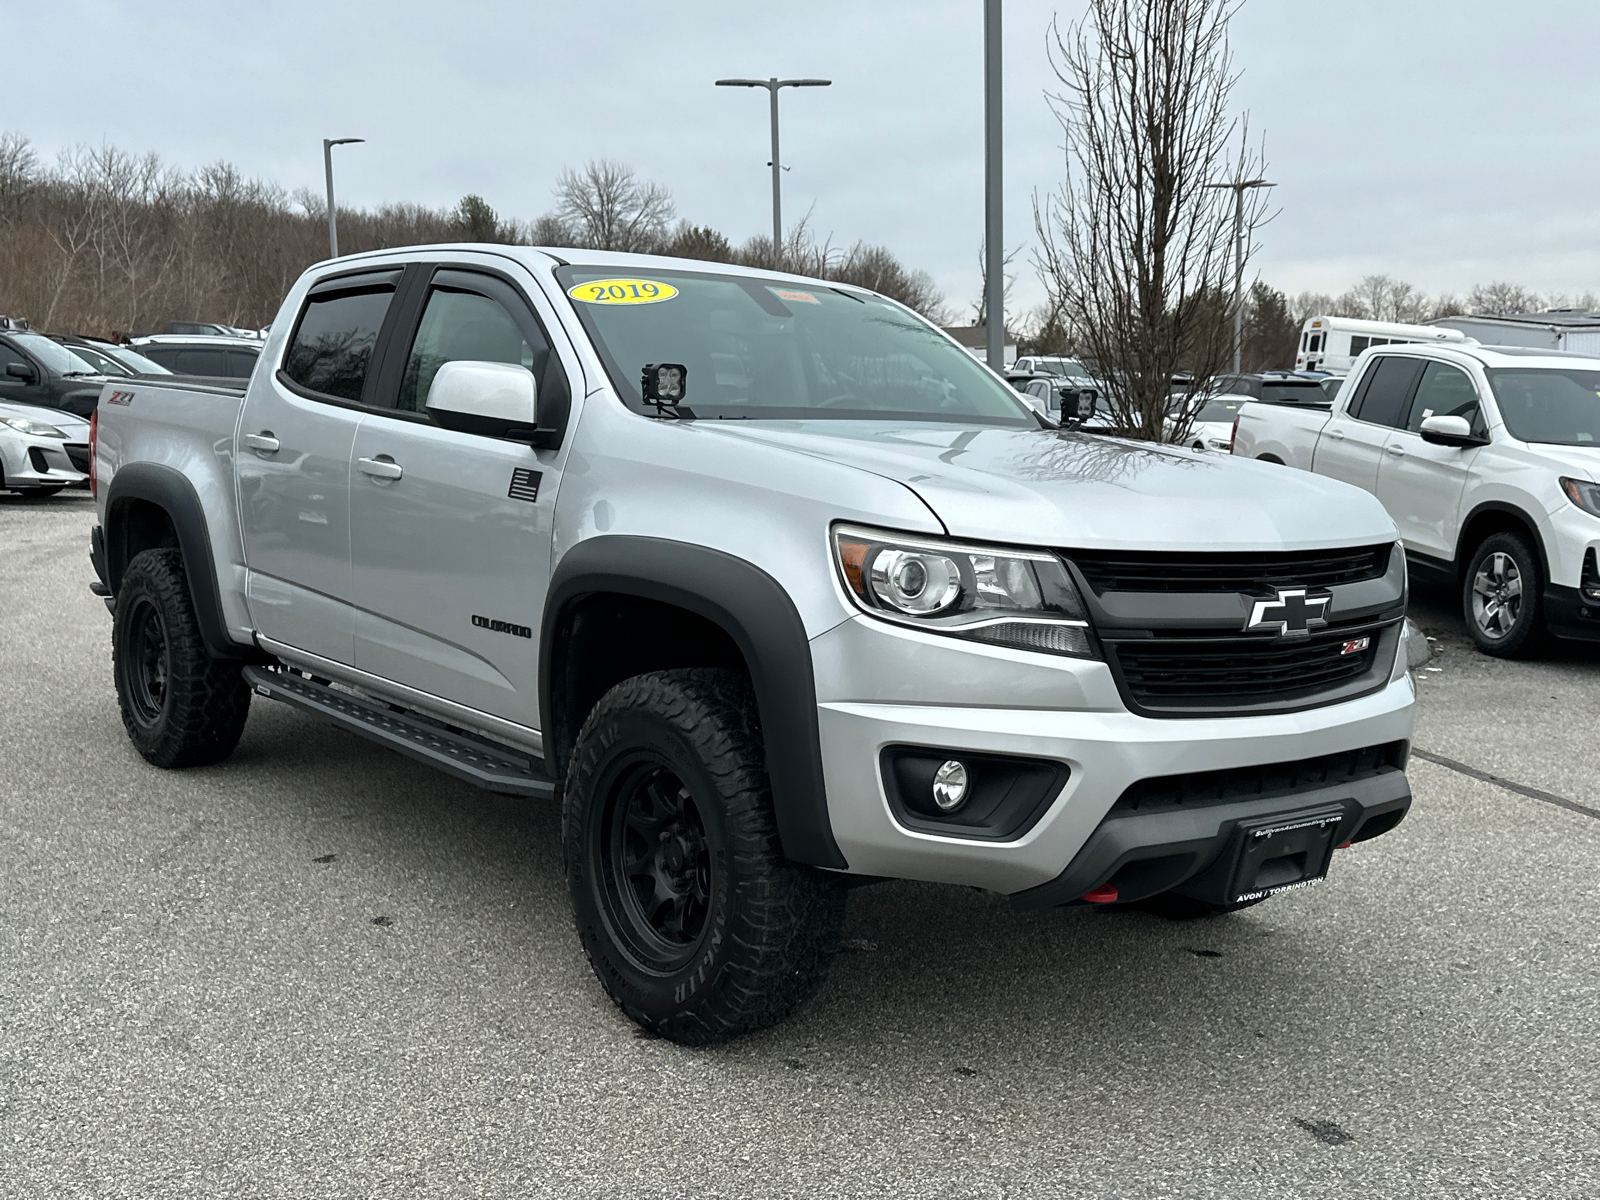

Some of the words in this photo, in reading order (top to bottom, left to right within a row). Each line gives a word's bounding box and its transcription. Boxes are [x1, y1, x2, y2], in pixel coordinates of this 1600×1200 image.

[589, 283, 660, 301] 2019
[108, 390, 136, 407] Z71
[471, 614, 532, 639] COLORADO
[1340, 636, 1371, 655] Z71
[1236, 891, 1262, 902] AVON
[1269, 876, 1324, 896] TORRINGTON
